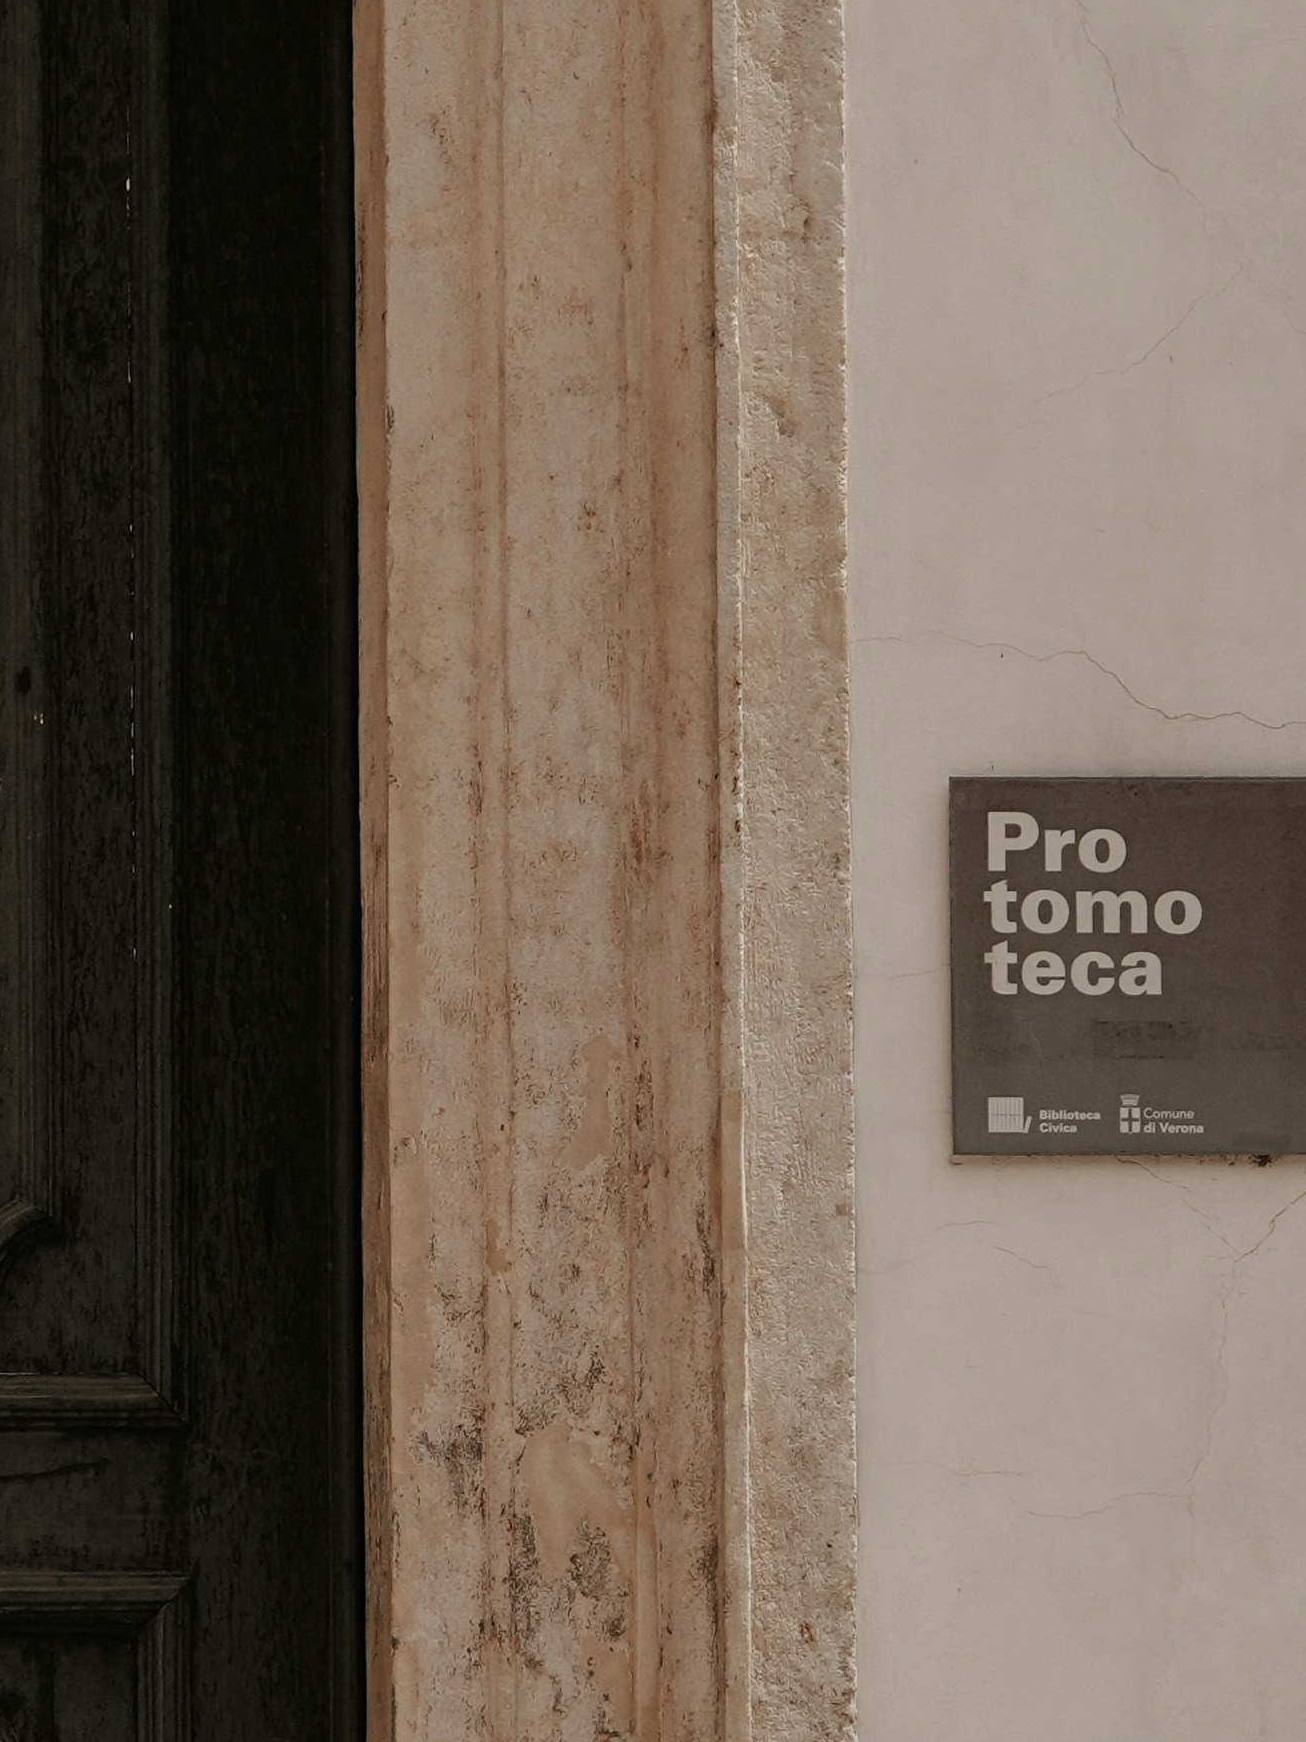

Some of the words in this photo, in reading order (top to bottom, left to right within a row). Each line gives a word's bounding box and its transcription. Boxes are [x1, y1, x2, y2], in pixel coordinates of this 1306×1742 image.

[988, 811, 1127, 873] Pro
[983, 879, 1203, 934] tomo
[984, 940, 1163, 996] teca
[1039, 1109, 1101, 1120] Biblioteca
[1143, 1107, 1195, 1119] Comune
[1039, 1122, 1078, 1134] Civica
[1143, 1122, 1155, 1134] di
[1159, 1122, 1204, 1134] Verona
